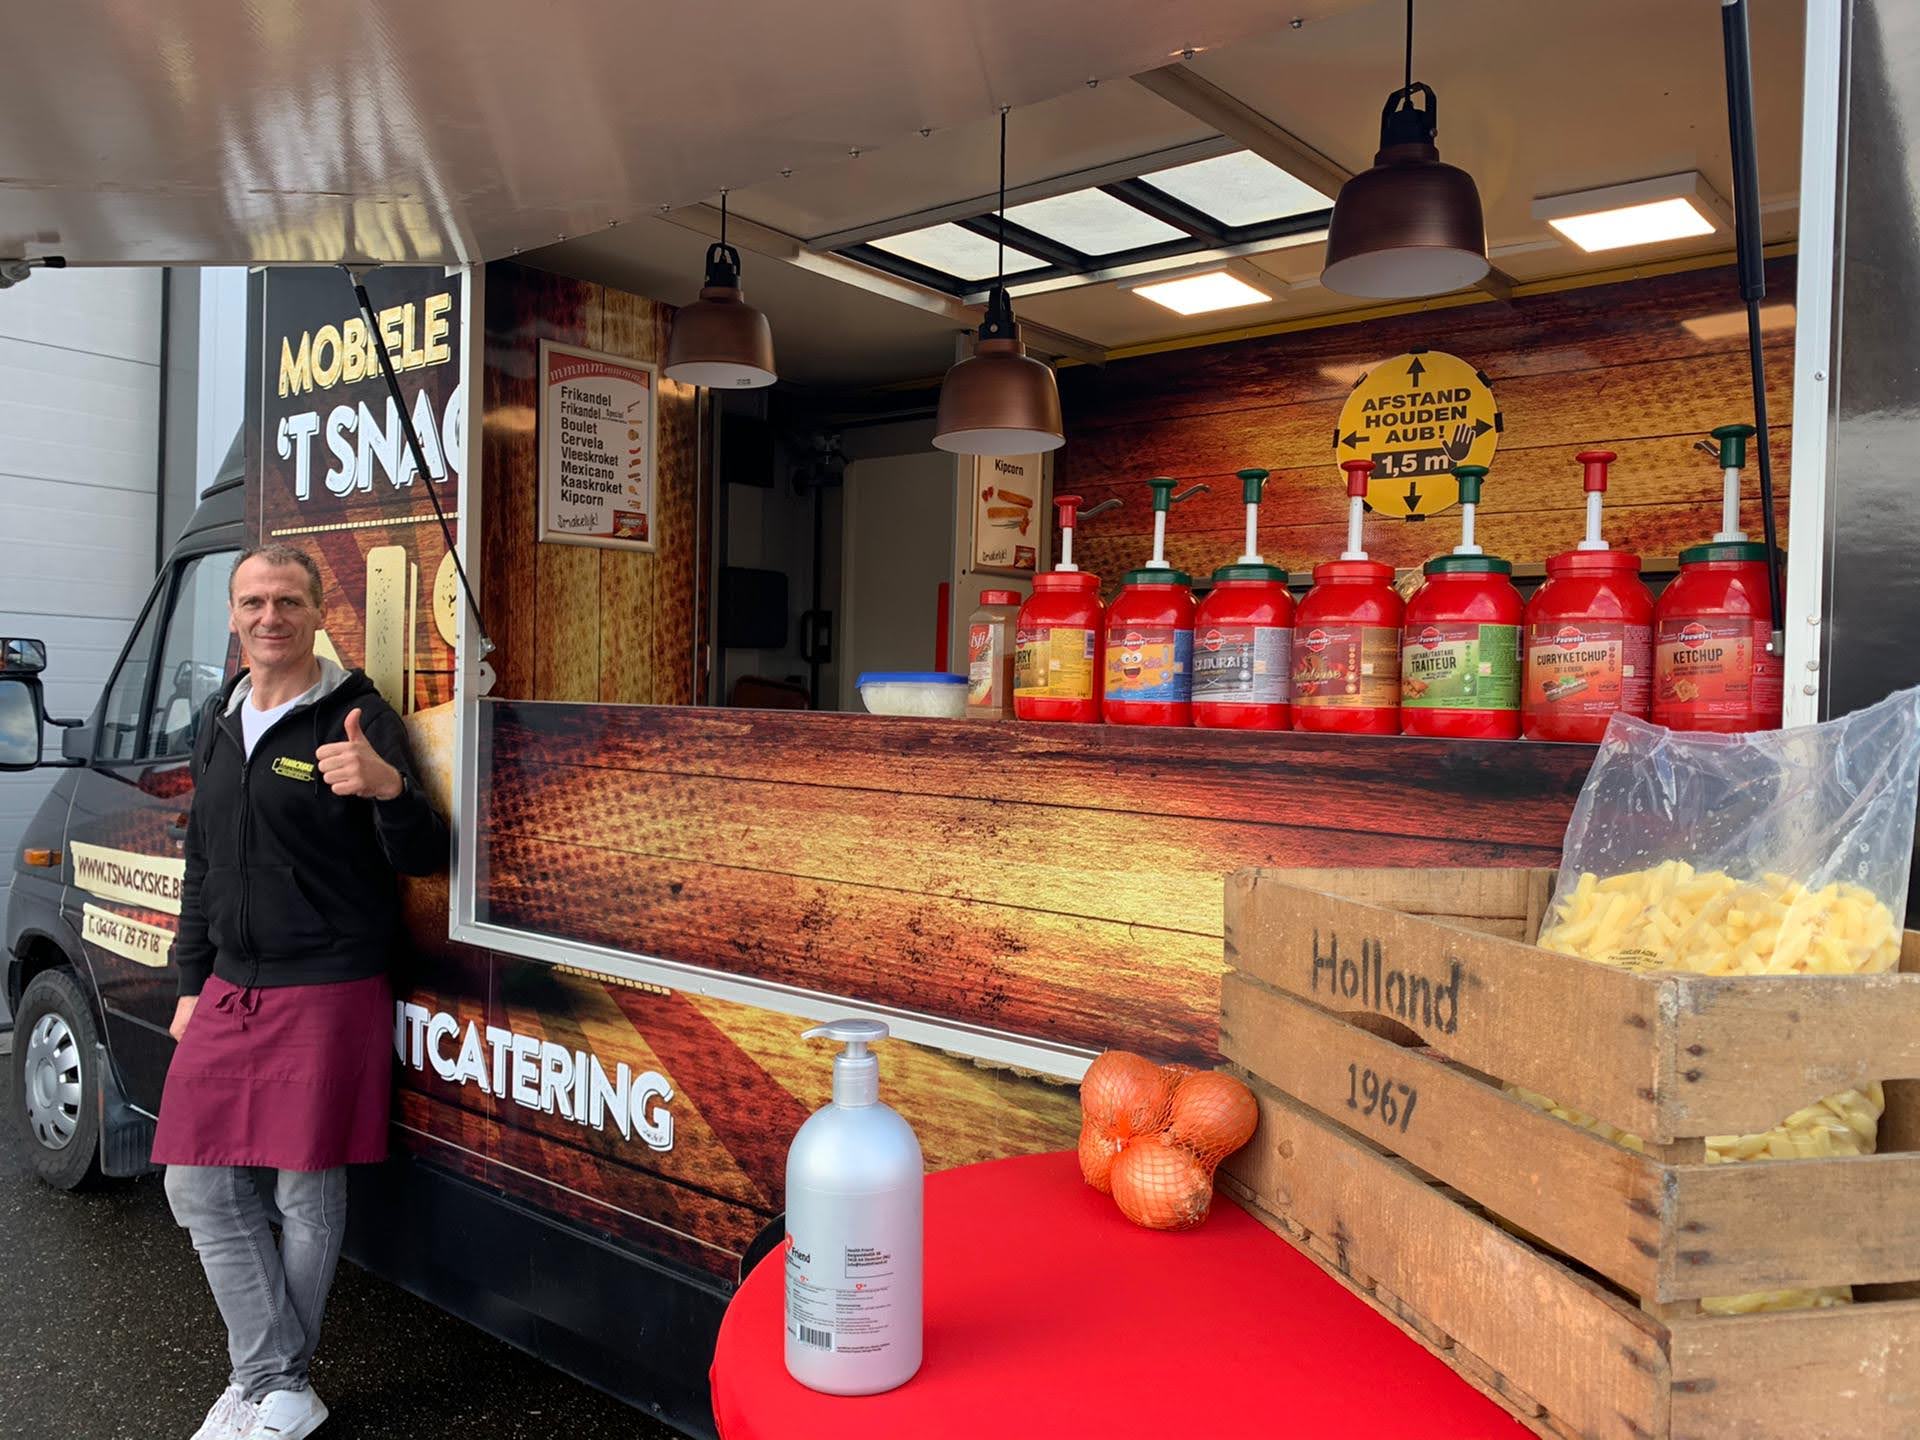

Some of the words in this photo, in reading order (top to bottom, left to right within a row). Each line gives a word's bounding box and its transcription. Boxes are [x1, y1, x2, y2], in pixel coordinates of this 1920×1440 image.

[278, 292, 452, 398] MOBIELE
[561, 386, 612, 406] Frikandel
[1361, 388, 1472, 413] AFSTAND
[560, 401, 601, 420] Frikandel
[1365, 406, 1467, 429] HOUDEN
[561, 416, 598, 434] Boulet
[561, 431, 604, 449] Cervela
[561, 446, 618, 466] Vleeskroket
[1381, 453, 1418, 478] 1,5
[1425, 454, 1448, 470] m
[561, 461, 614, 480] Mexicano
[995, 459, 1024, 476] Kipcorn
[561, 474, 622, 495] Kaaskroket
[561, 489, 604, 506] Kipcorn
[1555, 635, 1584, 644] Pauwels
[1680, 632, 1710, 642] Pauwels
[1411, 657, 1457, 673] TRAITEUR
[1537, 650, 1608, 665] CURRYKETCHUP
[1673, 648, 1723, 665] KETCHUP
[88, 915, 95, 934] T.
[96, 918, 118, 940] 0474
[124, 925, 136, 947] 29
[136, 928, 148, 949] 79
[149, 932, 161, 953] 18
[1312, 928, 1462, 1035] Holland
[1347, 1063, 1417, 1134] 1967
[791, 1246, 811, 1264] Friend
